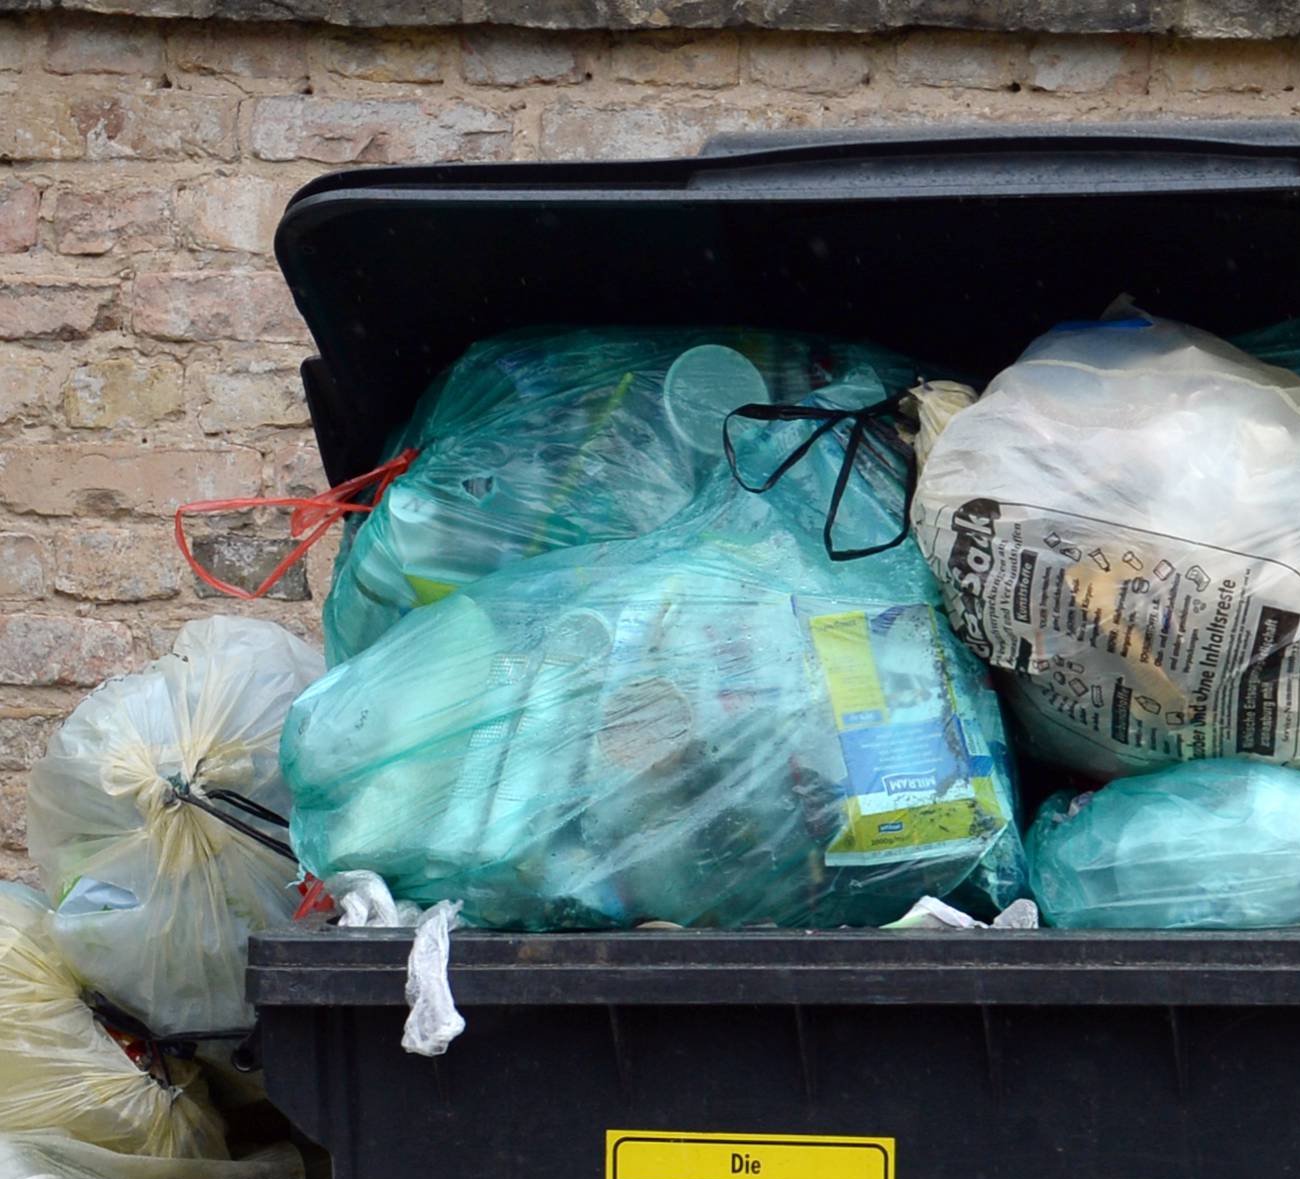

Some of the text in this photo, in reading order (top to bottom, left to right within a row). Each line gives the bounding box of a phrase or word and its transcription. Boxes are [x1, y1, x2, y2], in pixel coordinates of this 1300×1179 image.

[1199, 579, 1236, 668] Inhaltsreste
[888, 773, 936, 793] MILRAM
[731, 1153, 761, 1175] Die
